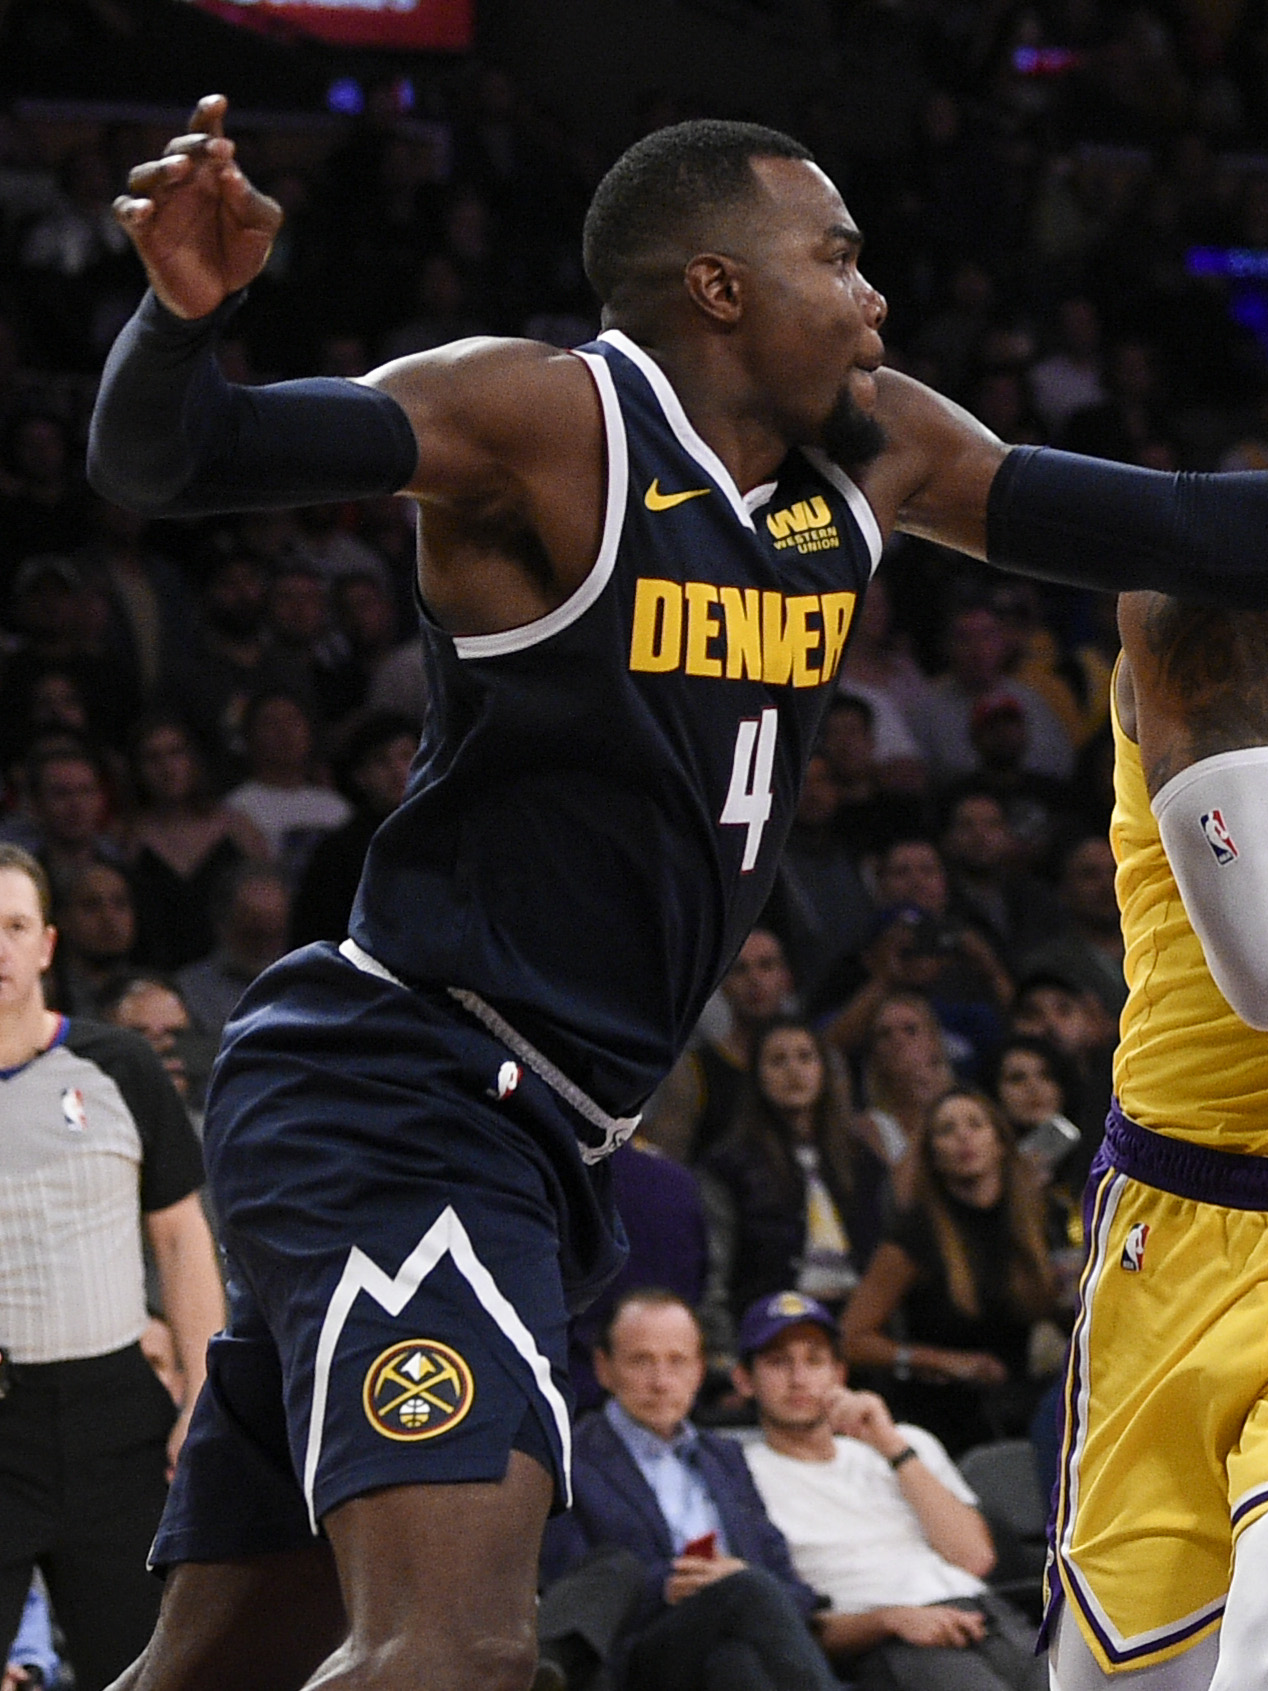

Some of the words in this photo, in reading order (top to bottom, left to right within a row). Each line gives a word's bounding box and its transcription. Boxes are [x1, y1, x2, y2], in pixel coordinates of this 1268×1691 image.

[766, 495, 832, 540] WU
[773, 526, 838, 550] WESTERN
[797, 537, 840, 554] UNION
[629, 577, 857, 688] DENVER
[718, 705, 779, 876] 4
